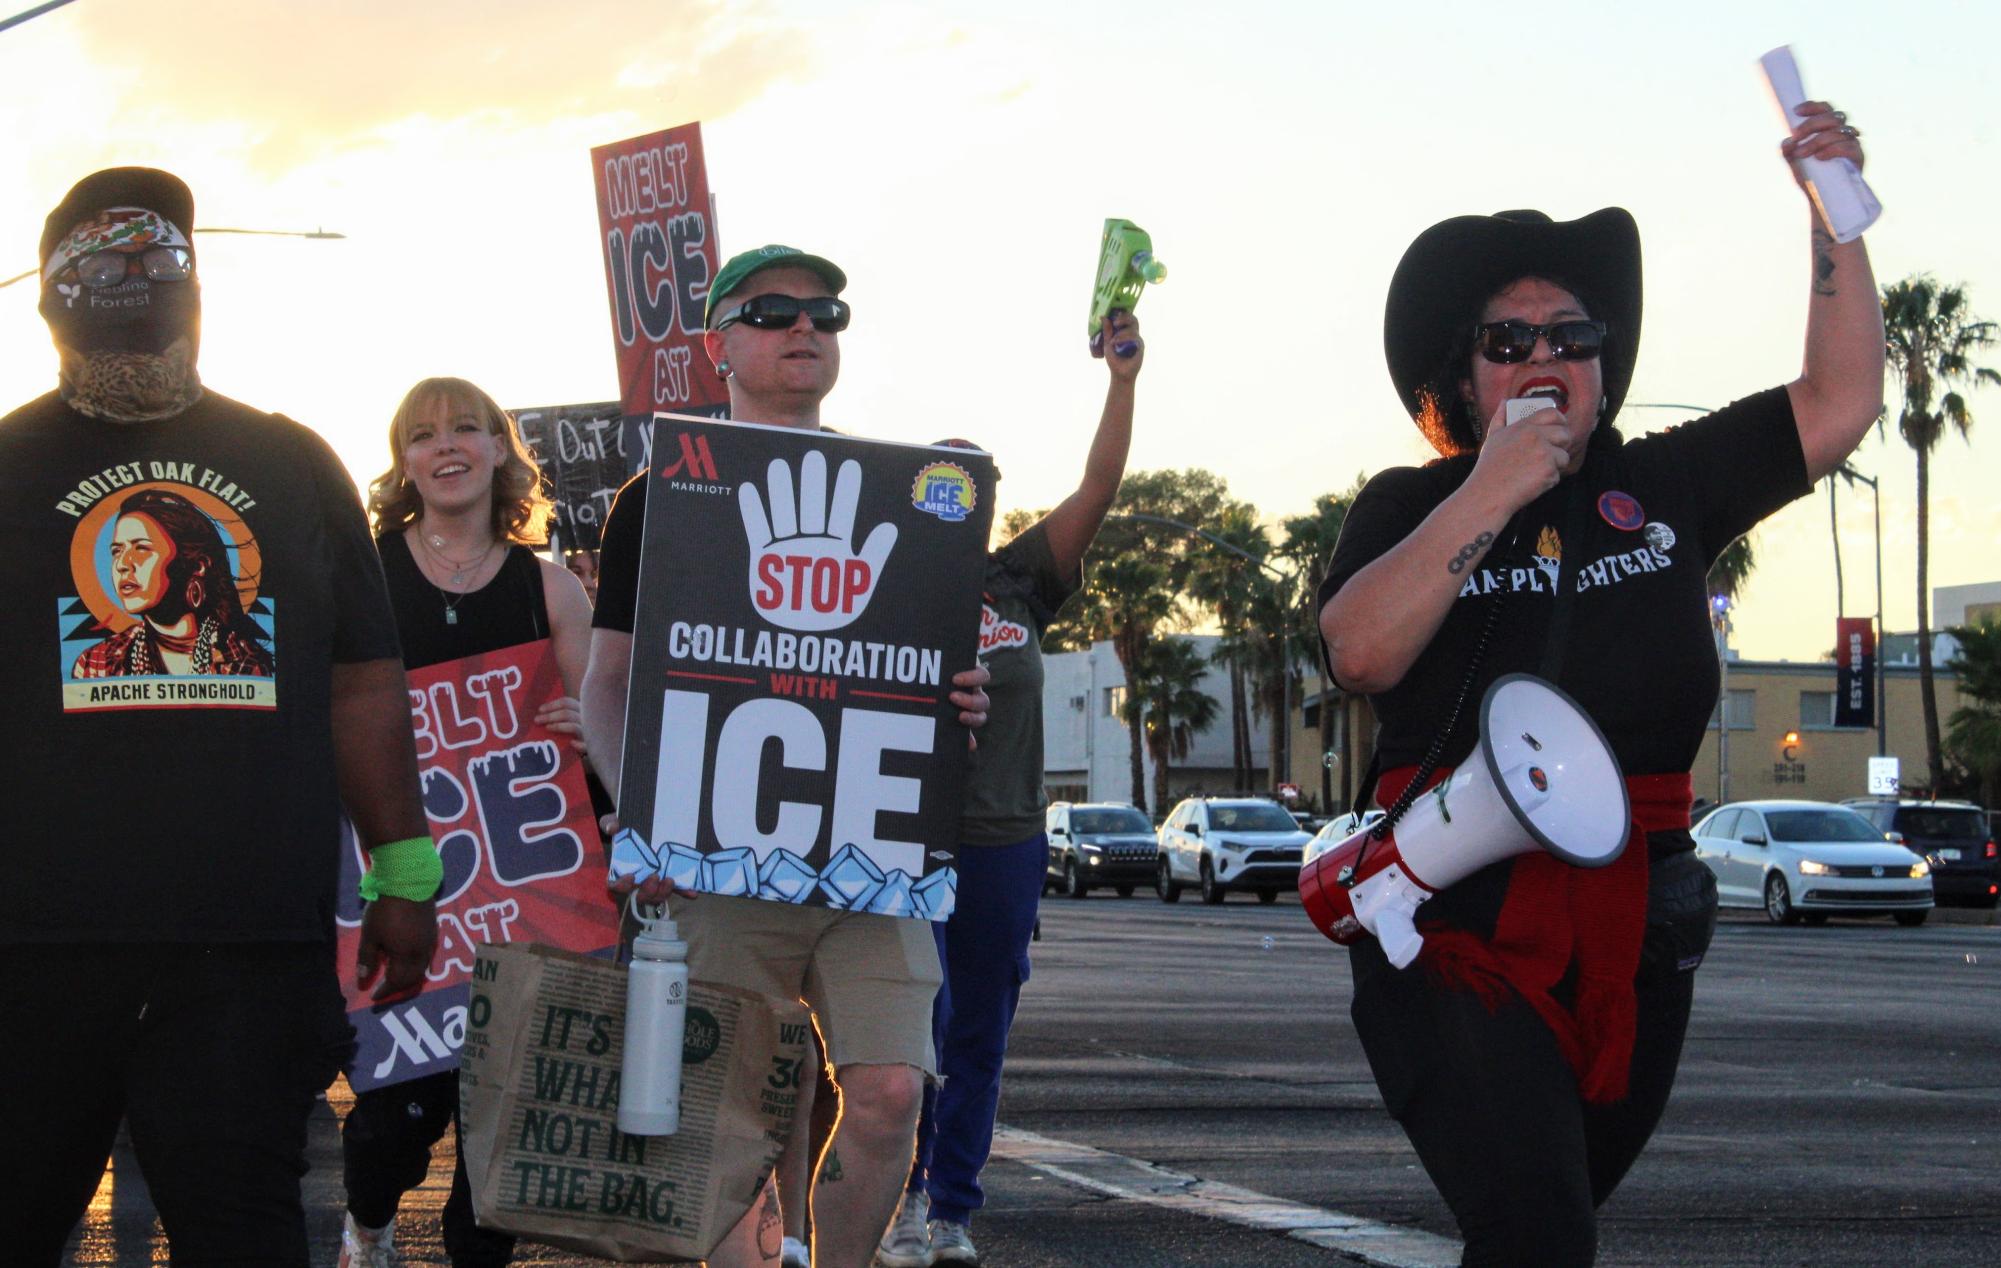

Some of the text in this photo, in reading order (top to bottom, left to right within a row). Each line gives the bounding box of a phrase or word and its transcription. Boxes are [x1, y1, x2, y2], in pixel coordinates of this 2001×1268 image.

[605, 142, 688, 219] MELT
[90, 293, 151, 308] Forest
[607, 211, 709, 346] ICE
[654, 345, 690, 404] AT
[55, 461, 257, 518] PROTECT OAK FLAT!
[671, 481, 732, 496] MARRIOTT
[924, 501, 960, 513] MELT
[925, 482, 964, 504] ICE
[927, 474, 965, 484] MARRIOTT
[756, 553, 871, 614] STOP
[669, 621, 942, 686] COLLABORATION
[1850, 633, 1862, 710] EST. 1885
[90, 683, 256, 702] APACHE STRONGHOLD
[770, 673, 838, 700] WITH
[652, 689, 937, 878] ICE
[541, 1005, 613, 1056] IT'S
[535, 1055, 646, 1112] WHA
[518, 1108, 599, 1159] NOT
[512, 1159, 684, 1228] THE BAG.
